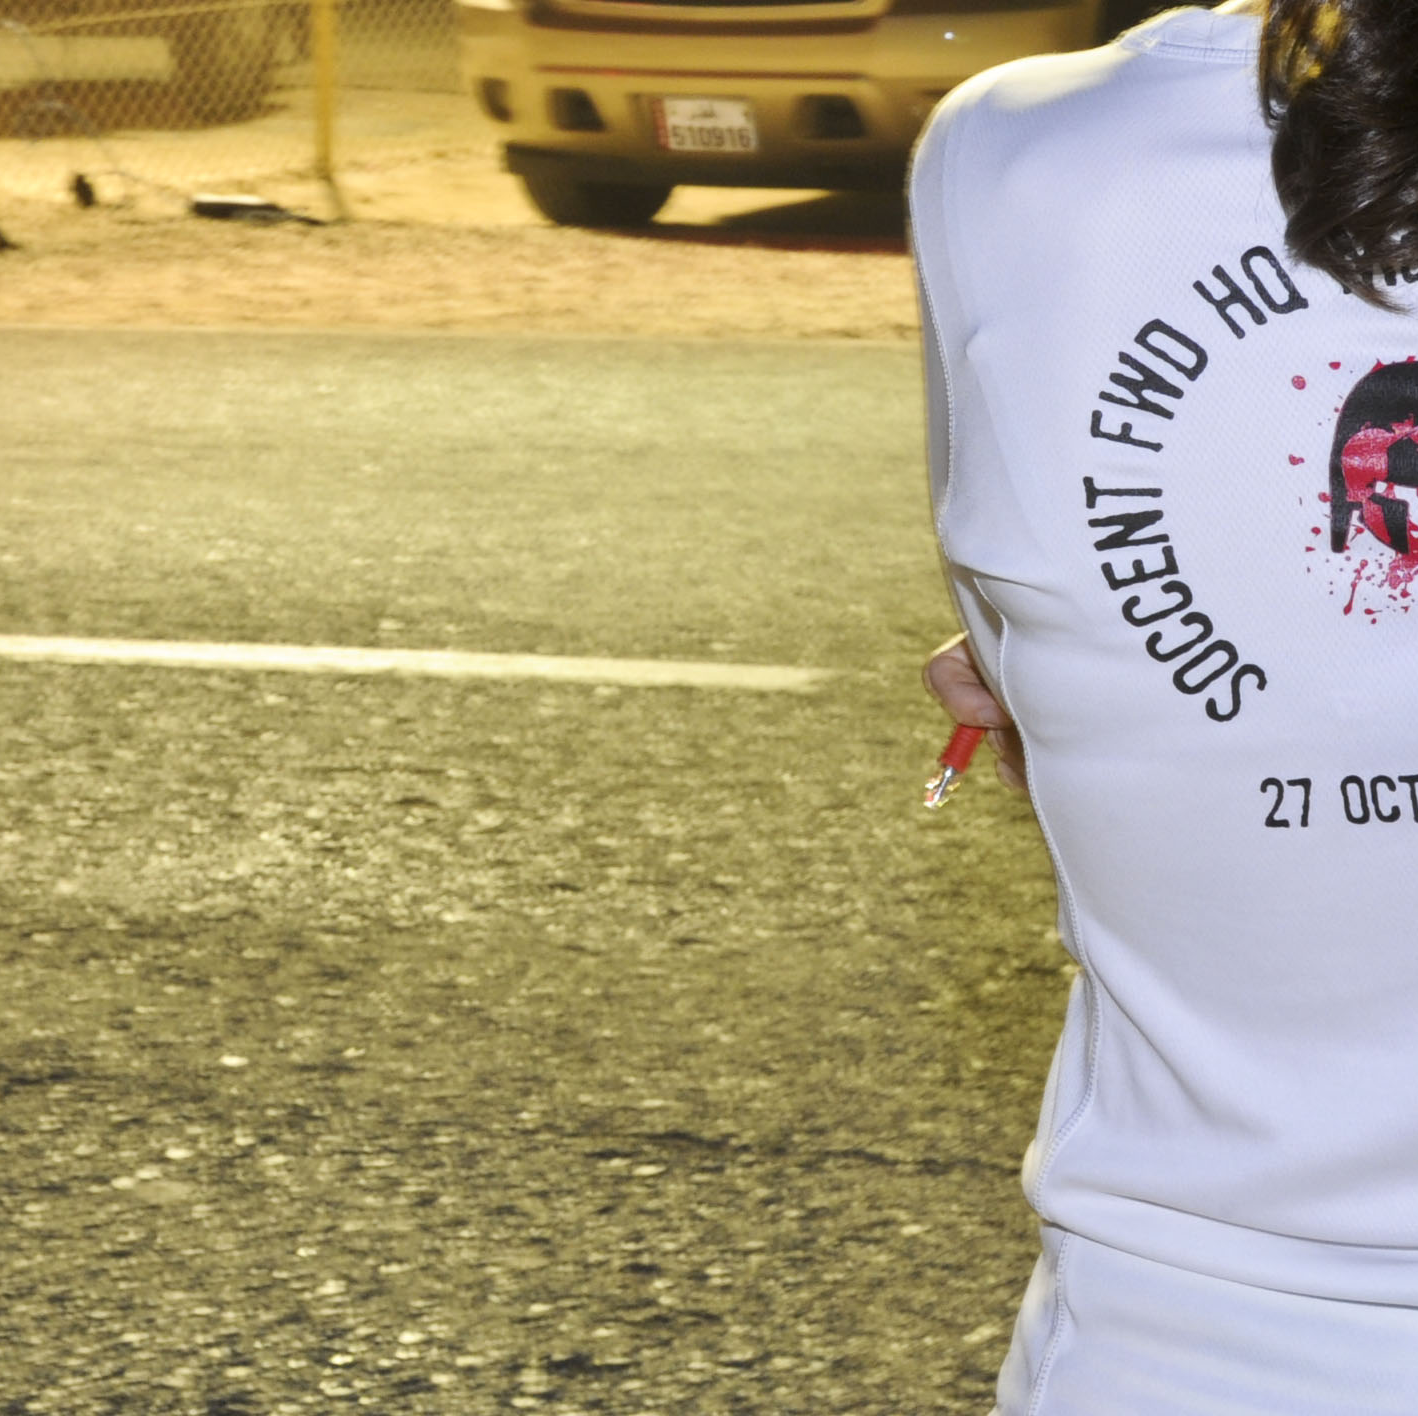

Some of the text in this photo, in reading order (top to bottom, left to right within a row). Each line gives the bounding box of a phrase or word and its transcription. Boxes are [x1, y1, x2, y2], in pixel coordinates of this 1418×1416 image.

[1192, 245, 1309, 339] HQ
[1090, 318, 1208, 452] FWD
[1082, 476, 1268, 723] SOCCENT
[1260, 777, 1312, 828] 27
